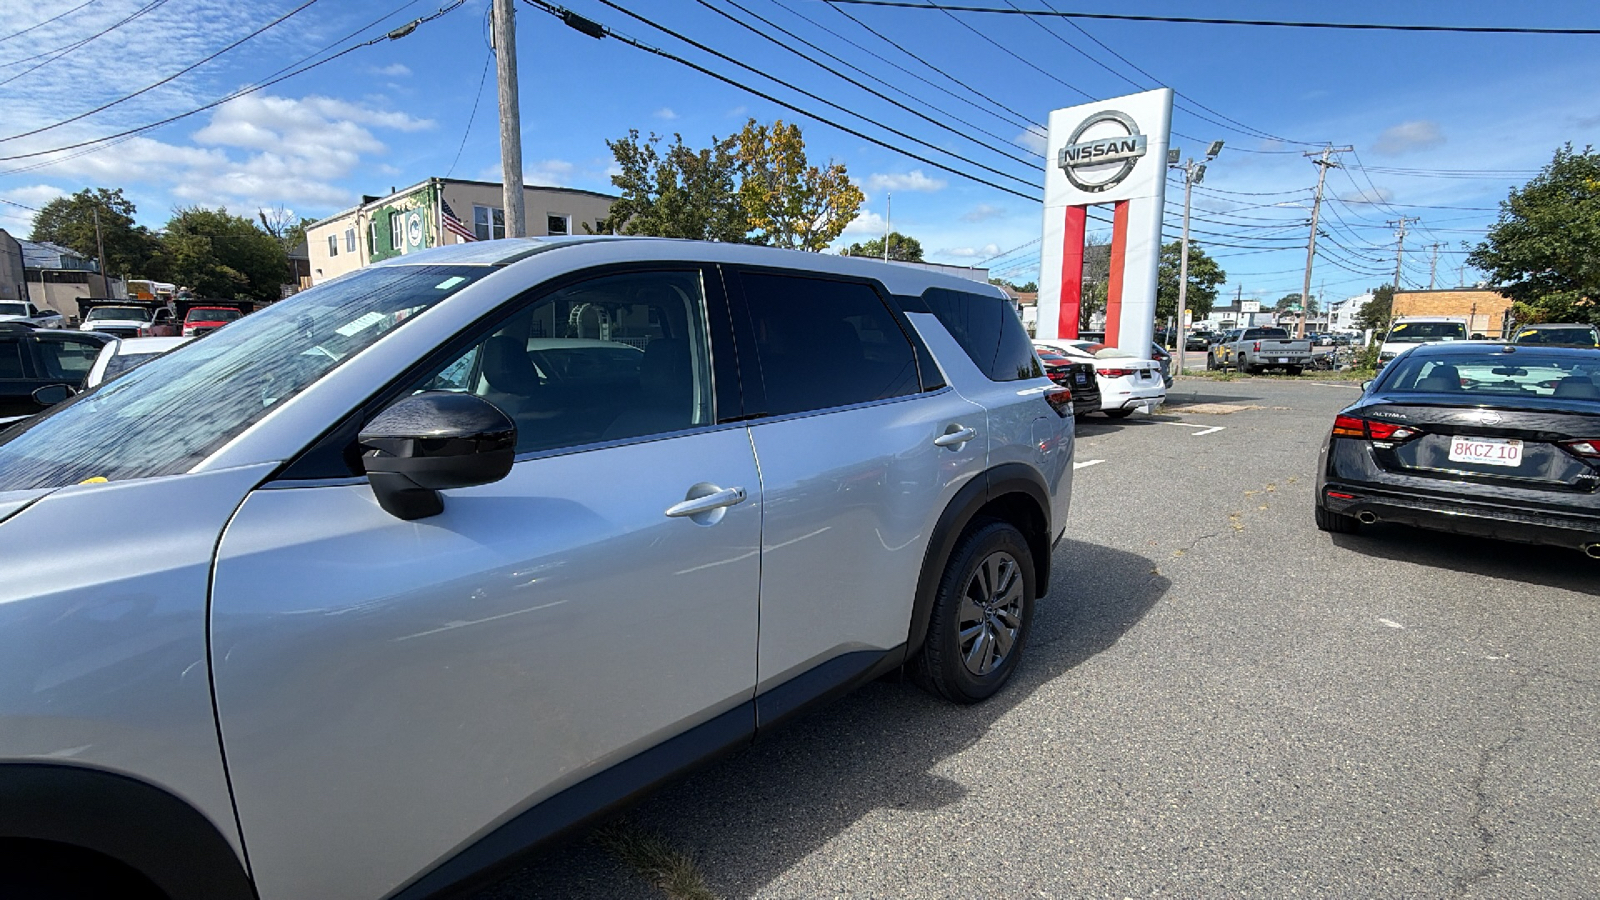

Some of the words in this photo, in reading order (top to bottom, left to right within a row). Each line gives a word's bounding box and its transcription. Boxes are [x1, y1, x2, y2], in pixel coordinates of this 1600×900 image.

[1064, 139, 1137, 162] NISSAN
[1372, 411, 1407, 419] ALTIMA
[1454, 442, 1494, 458] 8KCZ
[1496, 446, 1518, 460] 10
